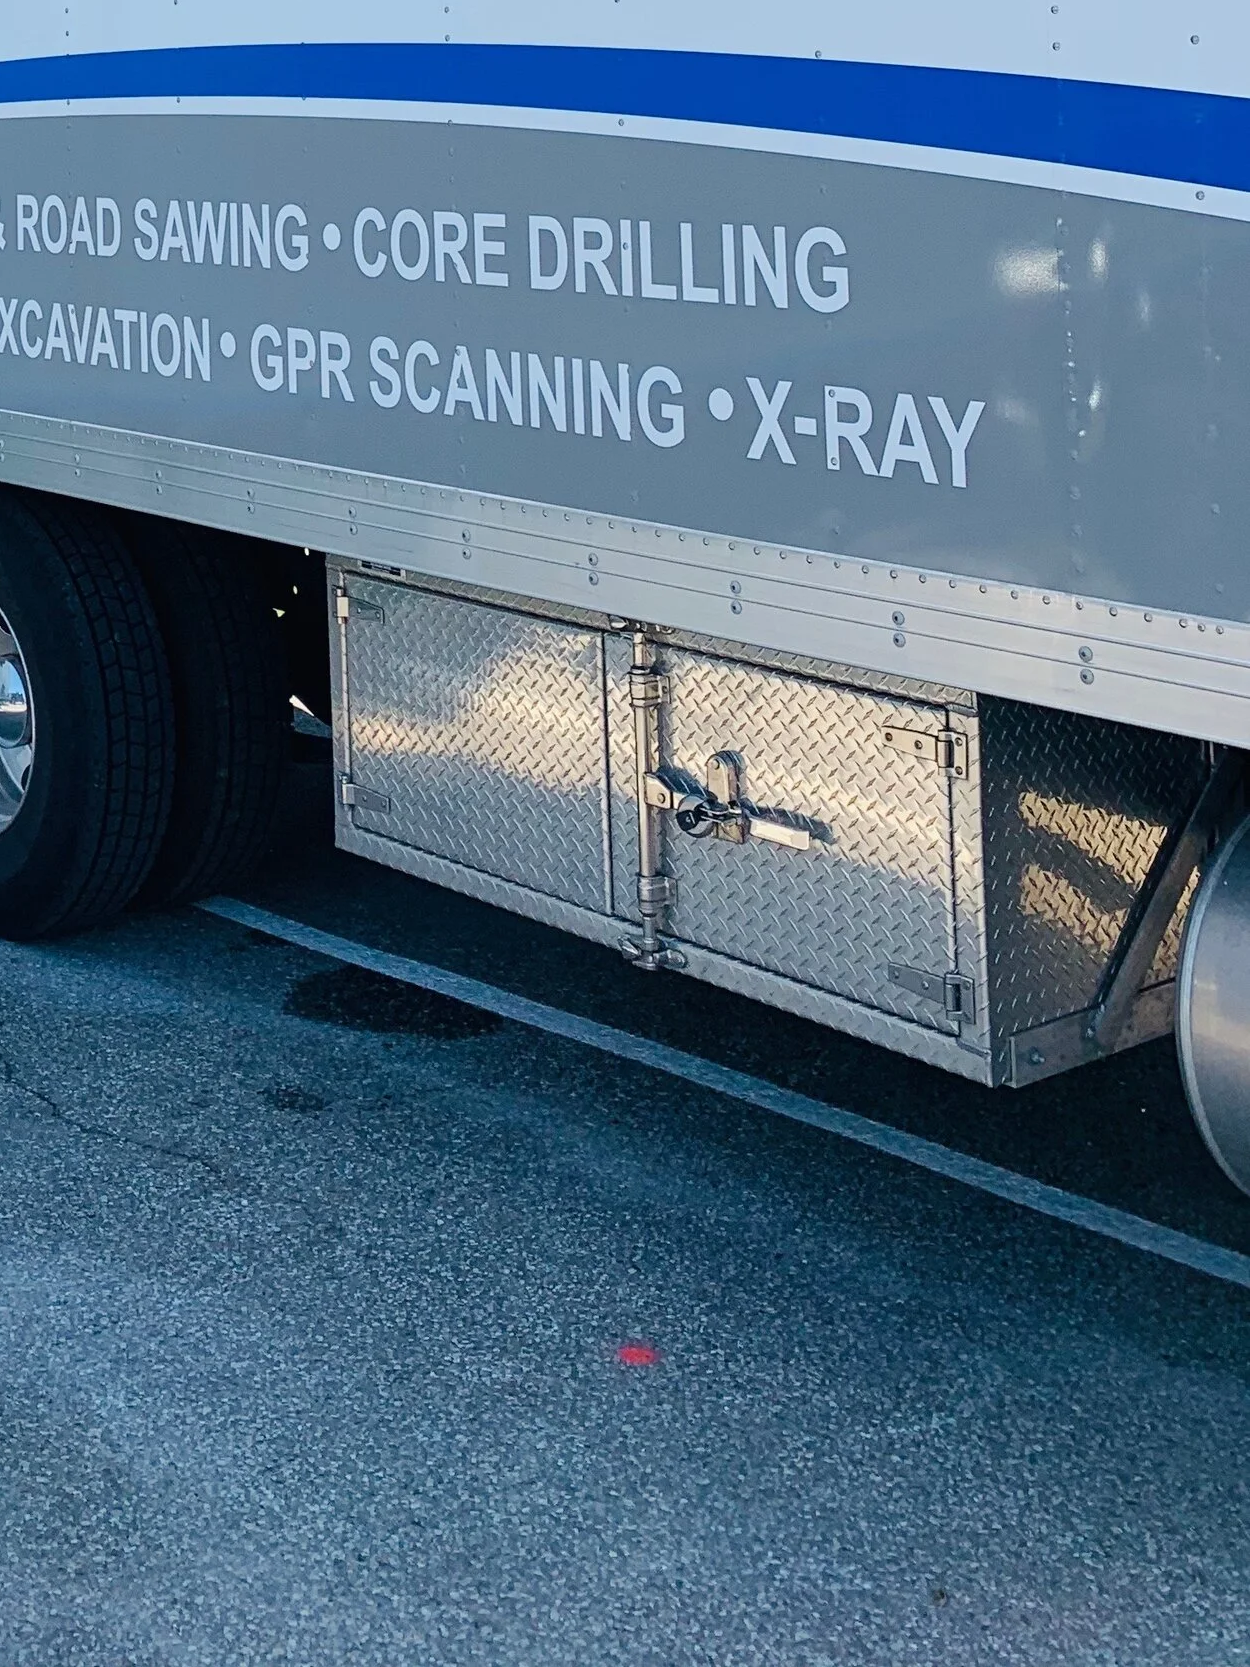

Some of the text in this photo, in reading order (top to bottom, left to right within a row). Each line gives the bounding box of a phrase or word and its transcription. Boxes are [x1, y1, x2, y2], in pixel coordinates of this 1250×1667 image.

[15, 193, 121, 257] ROAD
[132, 196, 309, 272] SAWING
[352, 206, 509, 287] CORE
[527, 214, 850, 313] DRILLING
[249, 322, 356, 402] GPR
[368, 334, 685, 448] SCANNING
[744, 375, 986, 488] X-RAY
